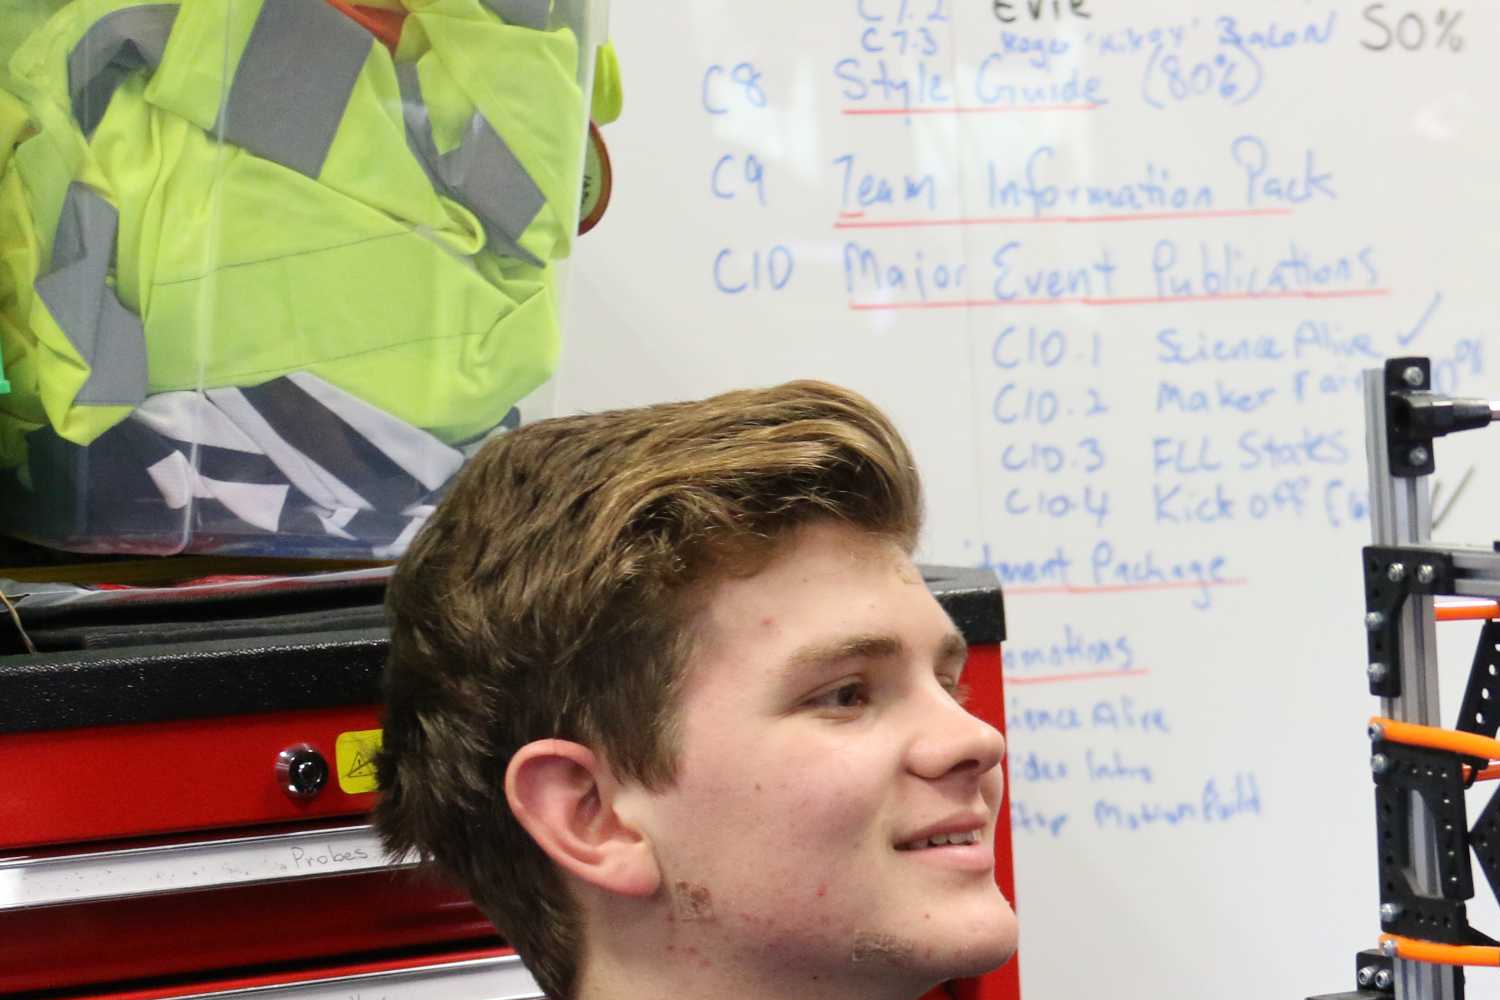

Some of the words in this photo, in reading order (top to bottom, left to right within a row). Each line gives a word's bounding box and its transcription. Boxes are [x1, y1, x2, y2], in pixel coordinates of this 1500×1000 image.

[702, 62, 767, 115] C8
[834, 57, 949, 125] Style
[976, 52, 1108, 105] Guide
[711, 153, 767, 207] C9
[832, 154, 937, 211] Team
[986, 145, 1214, 218] Information
[1231, 134, 1338, 204] Pack
[713, 245, 794, 294] C10
[843, 240, 968, 299] Major
[993, 240, 1116, 301] Event
[1151, 238, 1379, 298] Publications
[1153, 483, 1233, 524] Kick
[290, 844, 369, 869] Probes
